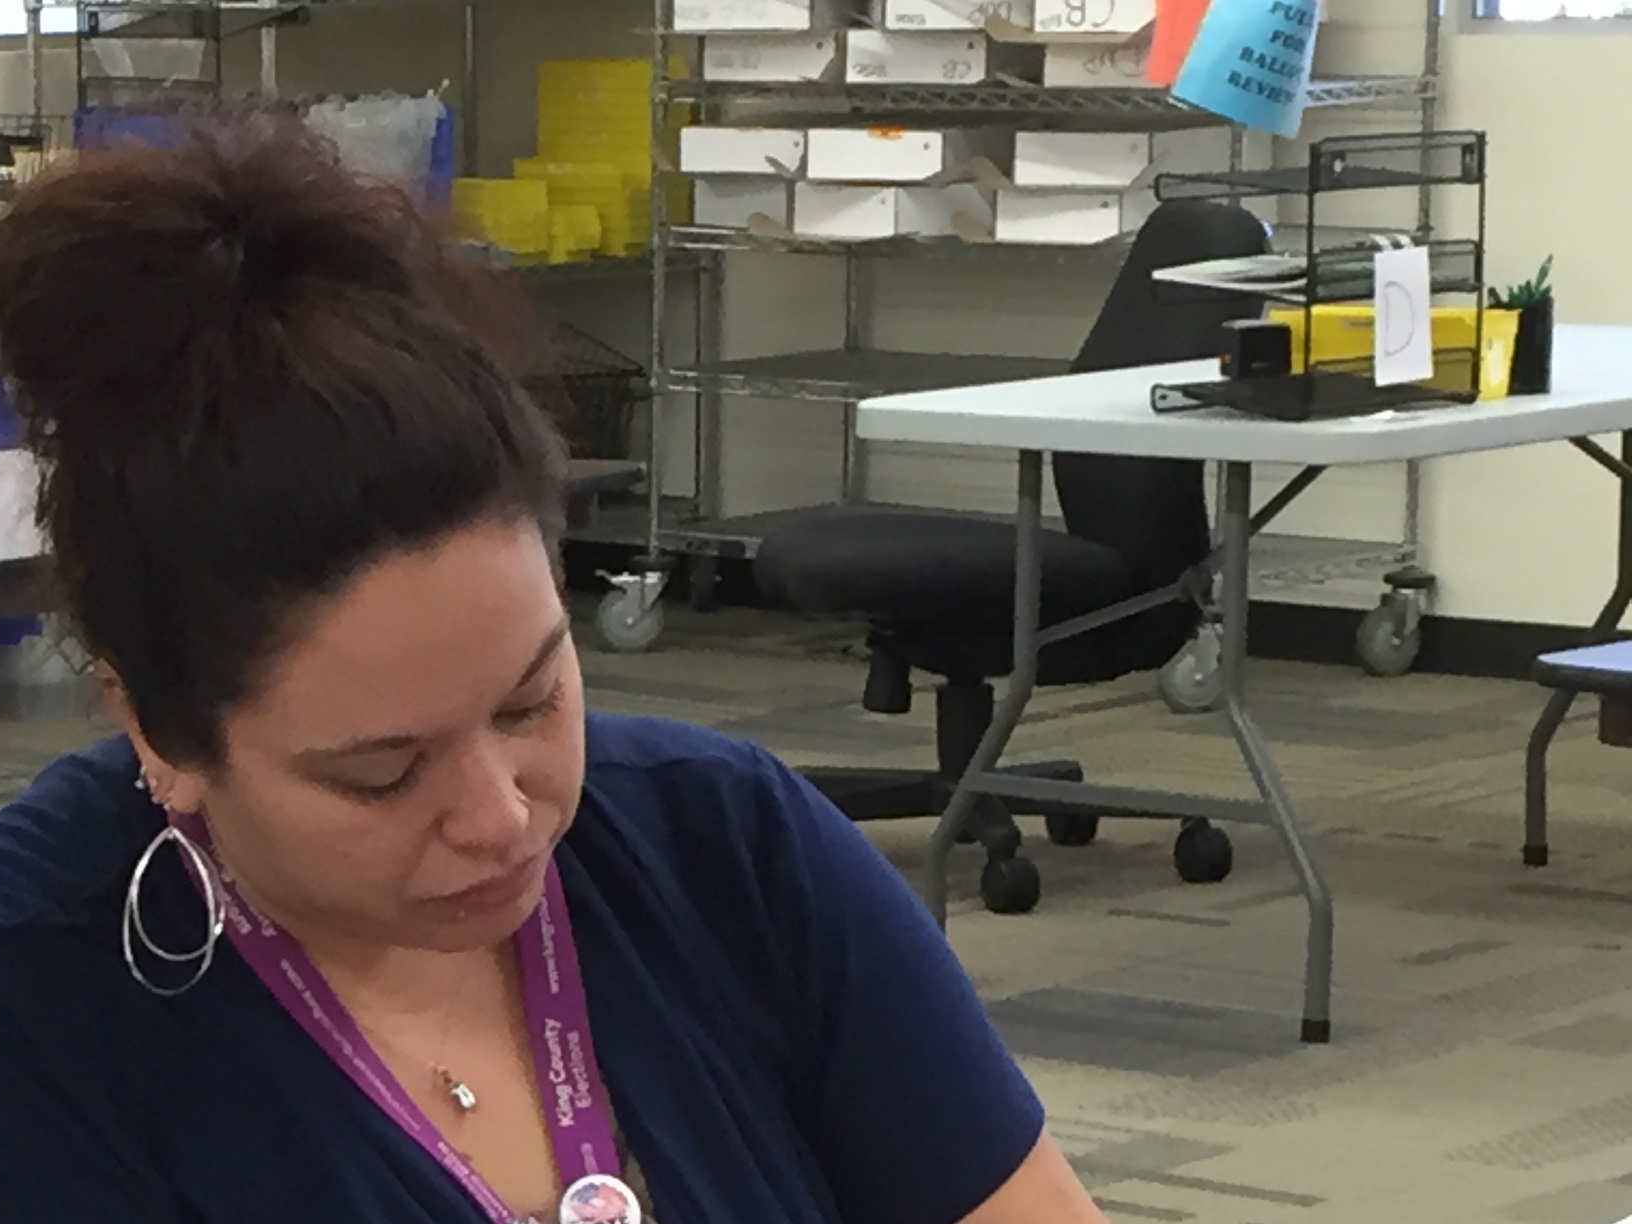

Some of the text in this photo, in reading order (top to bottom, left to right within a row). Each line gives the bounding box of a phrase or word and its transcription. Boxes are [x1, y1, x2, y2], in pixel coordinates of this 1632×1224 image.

[1383, 280, 1415, 357] D
[545, 1018, 576, 1127] King County
[565, 1031, 592, 1109] Elections
